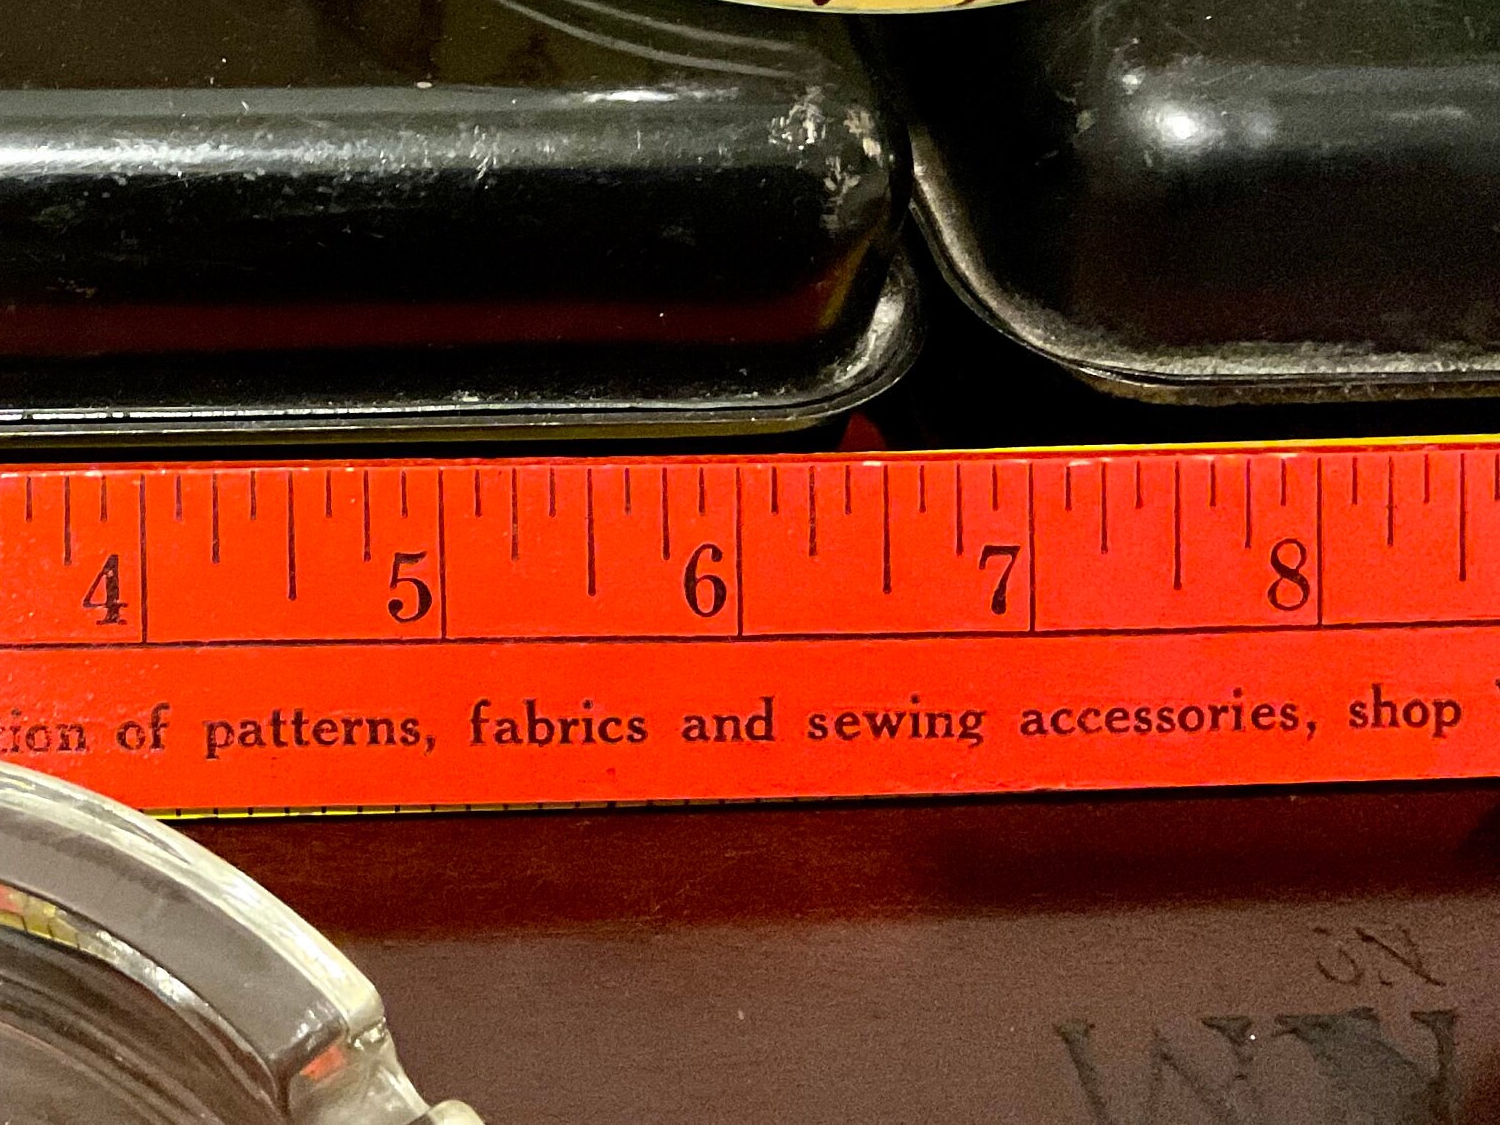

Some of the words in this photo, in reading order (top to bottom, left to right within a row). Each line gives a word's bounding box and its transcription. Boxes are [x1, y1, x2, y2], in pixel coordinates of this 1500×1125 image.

[82, 554, 127, 625] 4
[387, 552, 433, 624] 5
[683, 543, 727, 618] 6
[979, 544, 1021, 615] 7
[1267, 538, 1310, 612] 8
[116, 703, 172, 751] of
[206, 710, 436, 760] patterns,
[470, 699, 647, 748] fabrics
[681, 696, 775, 742] and
[807, 695, 986, 747] sewing
[1020, 689, 1317, 737] accessories,
[1349, 683, 1462, 738] shop
